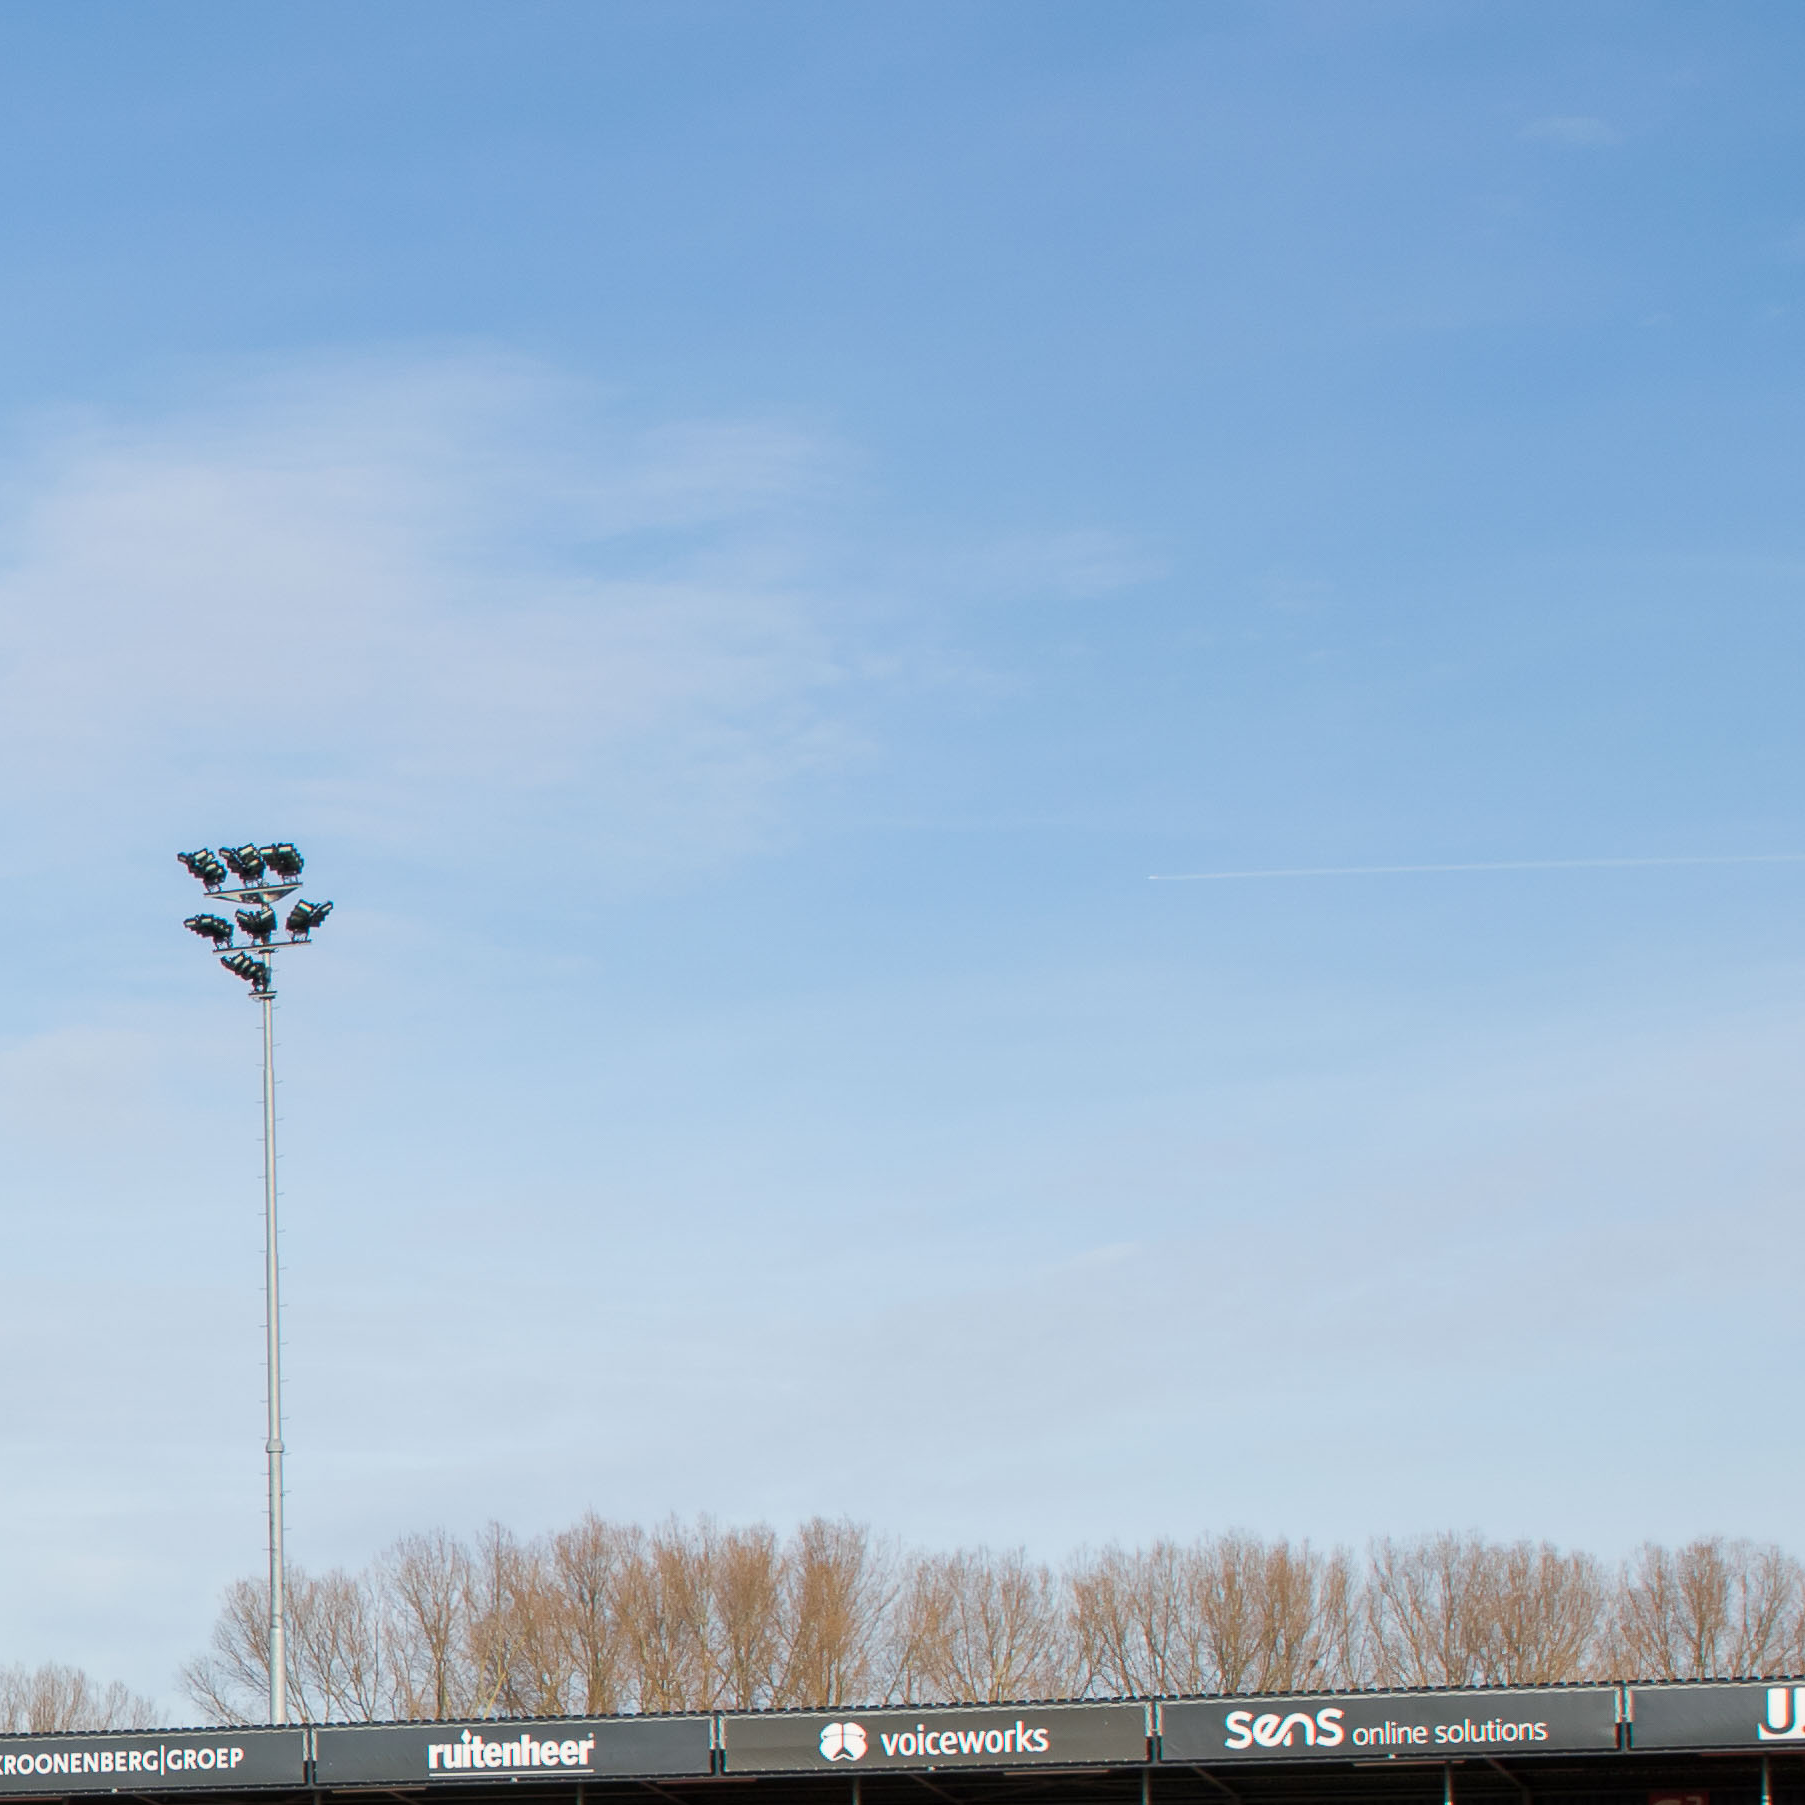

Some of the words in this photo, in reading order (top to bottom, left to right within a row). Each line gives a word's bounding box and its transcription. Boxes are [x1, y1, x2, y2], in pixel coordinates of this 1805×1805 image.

[880, 1721, 1050, 1757] voiceworks
[1353, 1721, 1428, 1745] online
[1435, 1718, 1547, 1744] solutions
